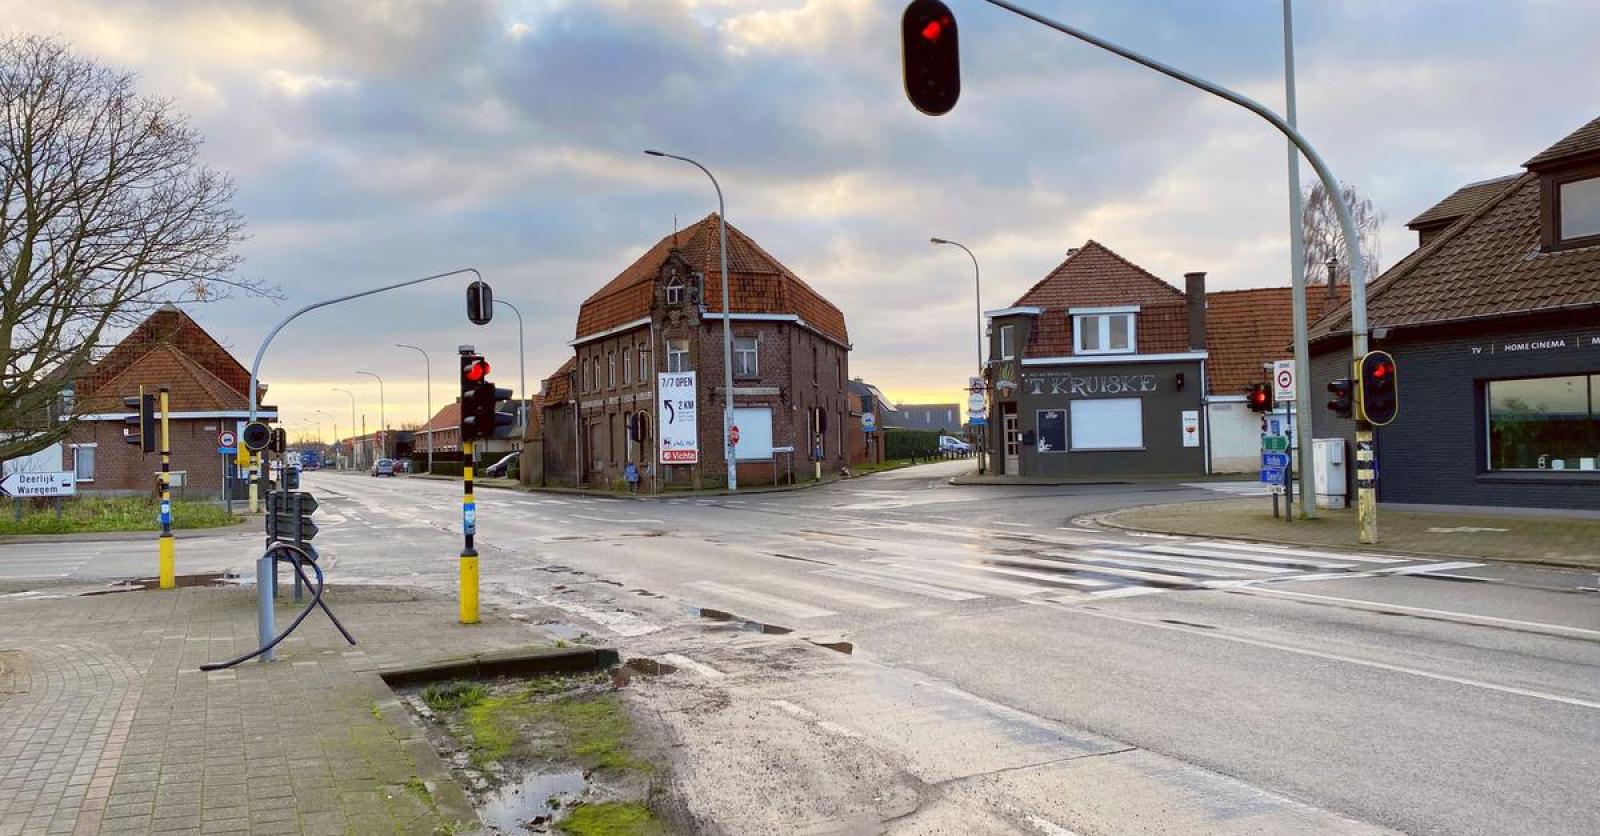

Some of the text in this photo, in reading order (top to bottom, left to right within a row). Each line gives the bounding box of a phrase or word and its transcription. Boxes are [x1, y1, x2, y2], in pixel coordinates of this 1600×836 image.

[1504, 340, 1565, 351] HOME CINEMA
[661, 377, 692, 387] 7/7 OPEN
[1051, 374, 1157, 396] KRUISKE
[20, 475, 54, 484] Deerlijk
[17, 486, 58, 495] Waregem
